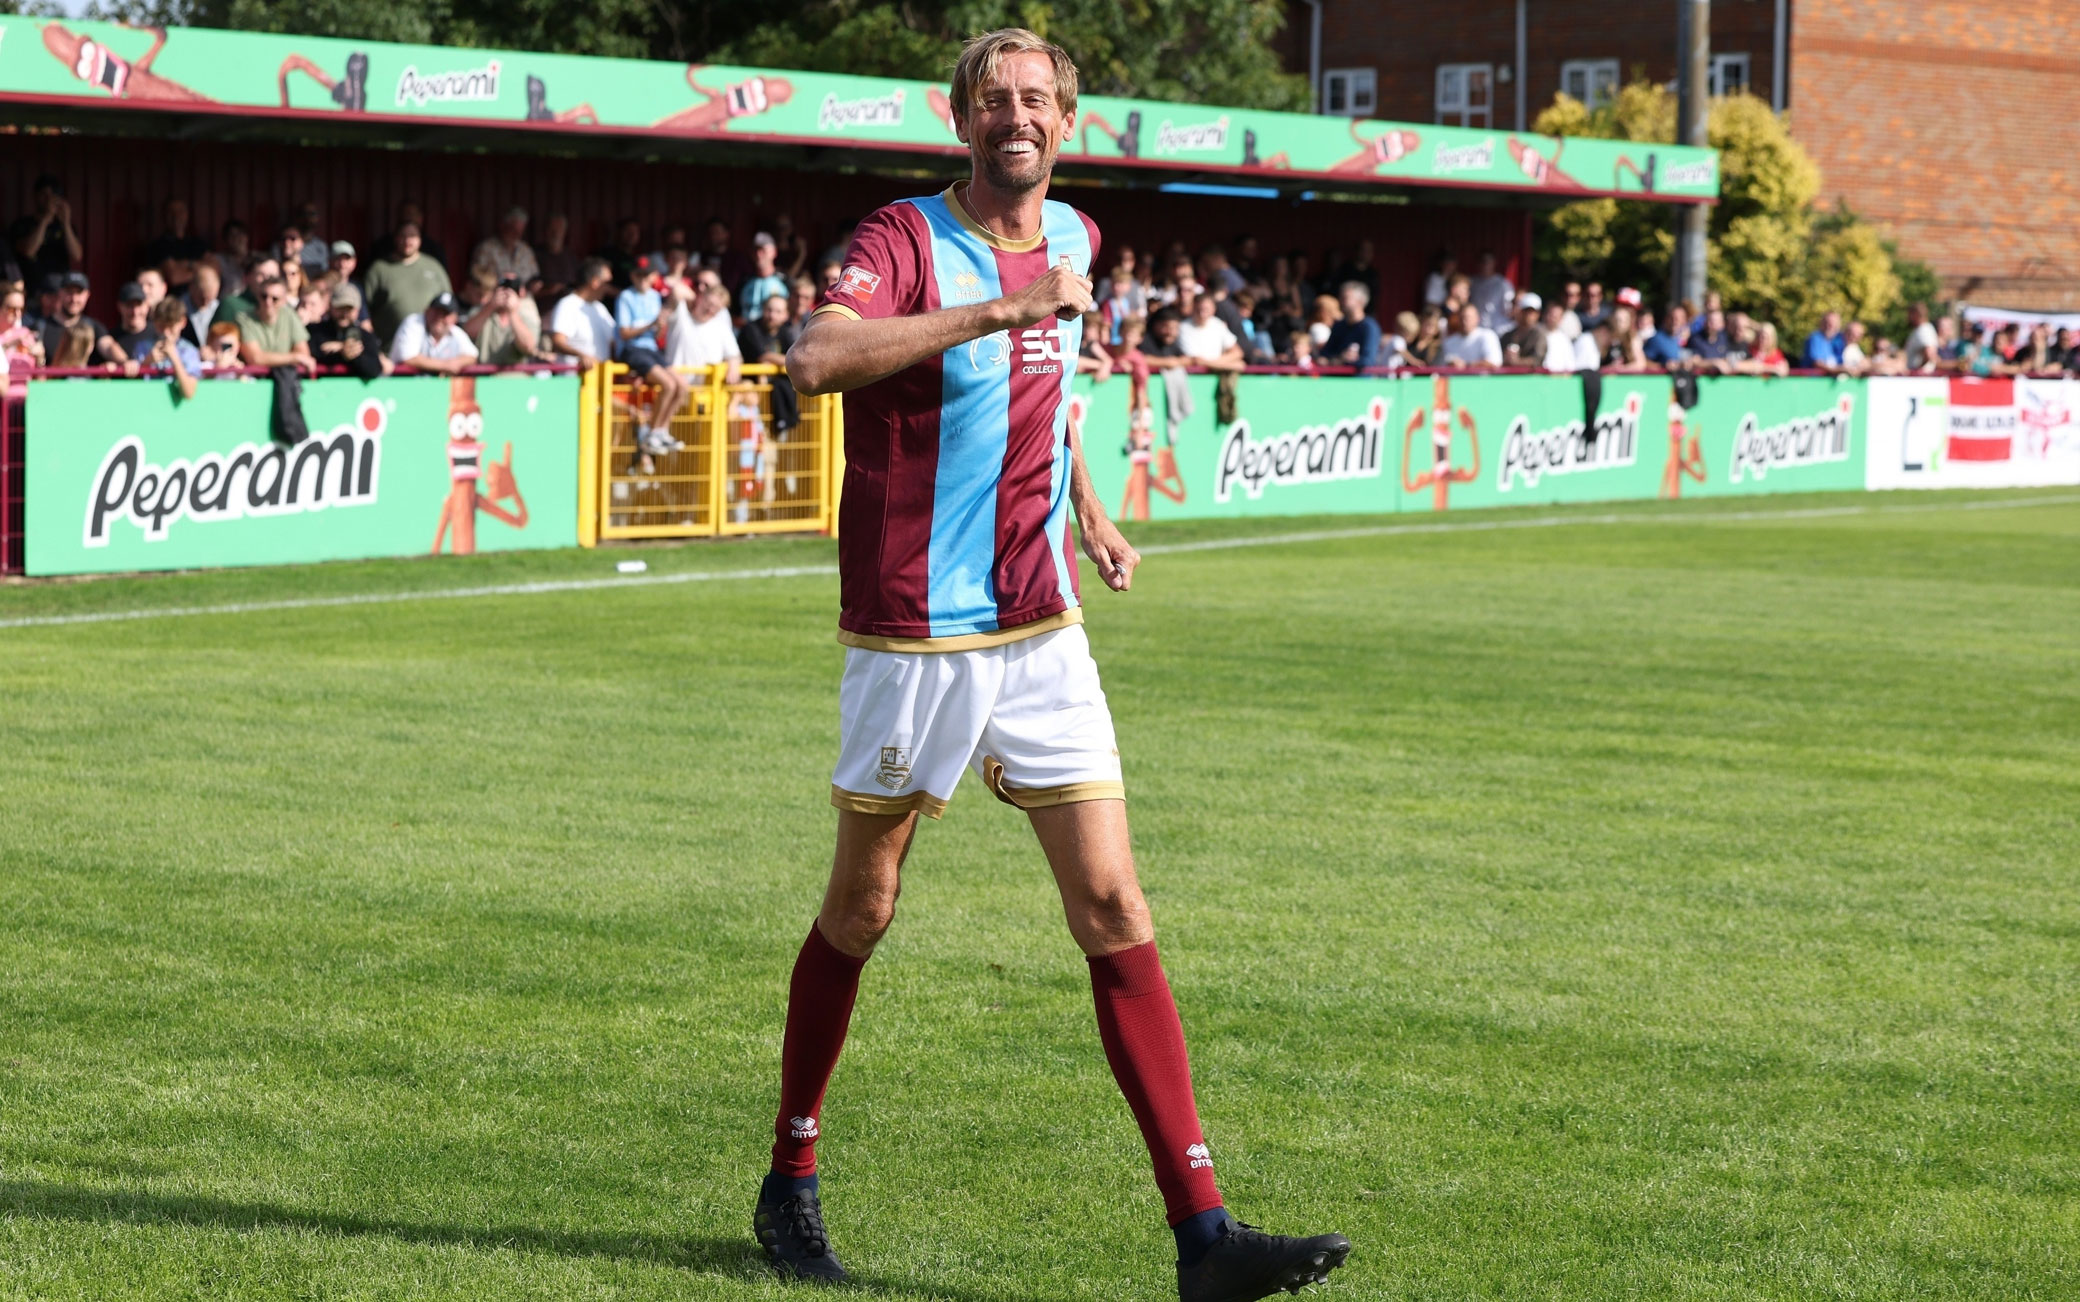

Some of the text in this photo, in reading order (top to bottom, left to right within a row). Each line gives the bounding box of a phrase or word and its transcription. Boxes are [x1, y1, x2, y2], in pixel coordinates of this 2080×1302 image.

[398, 64, 498, 102] Peperami
[1022, 364, 1058, 375] COLLEGE
[1220, 402, 1382, 495] Peperami
[1732, 399, 1850, 477] Peperami
[88, 405, 382, 540] Peperami
[1190, 1158, 1214, 1169] erre
